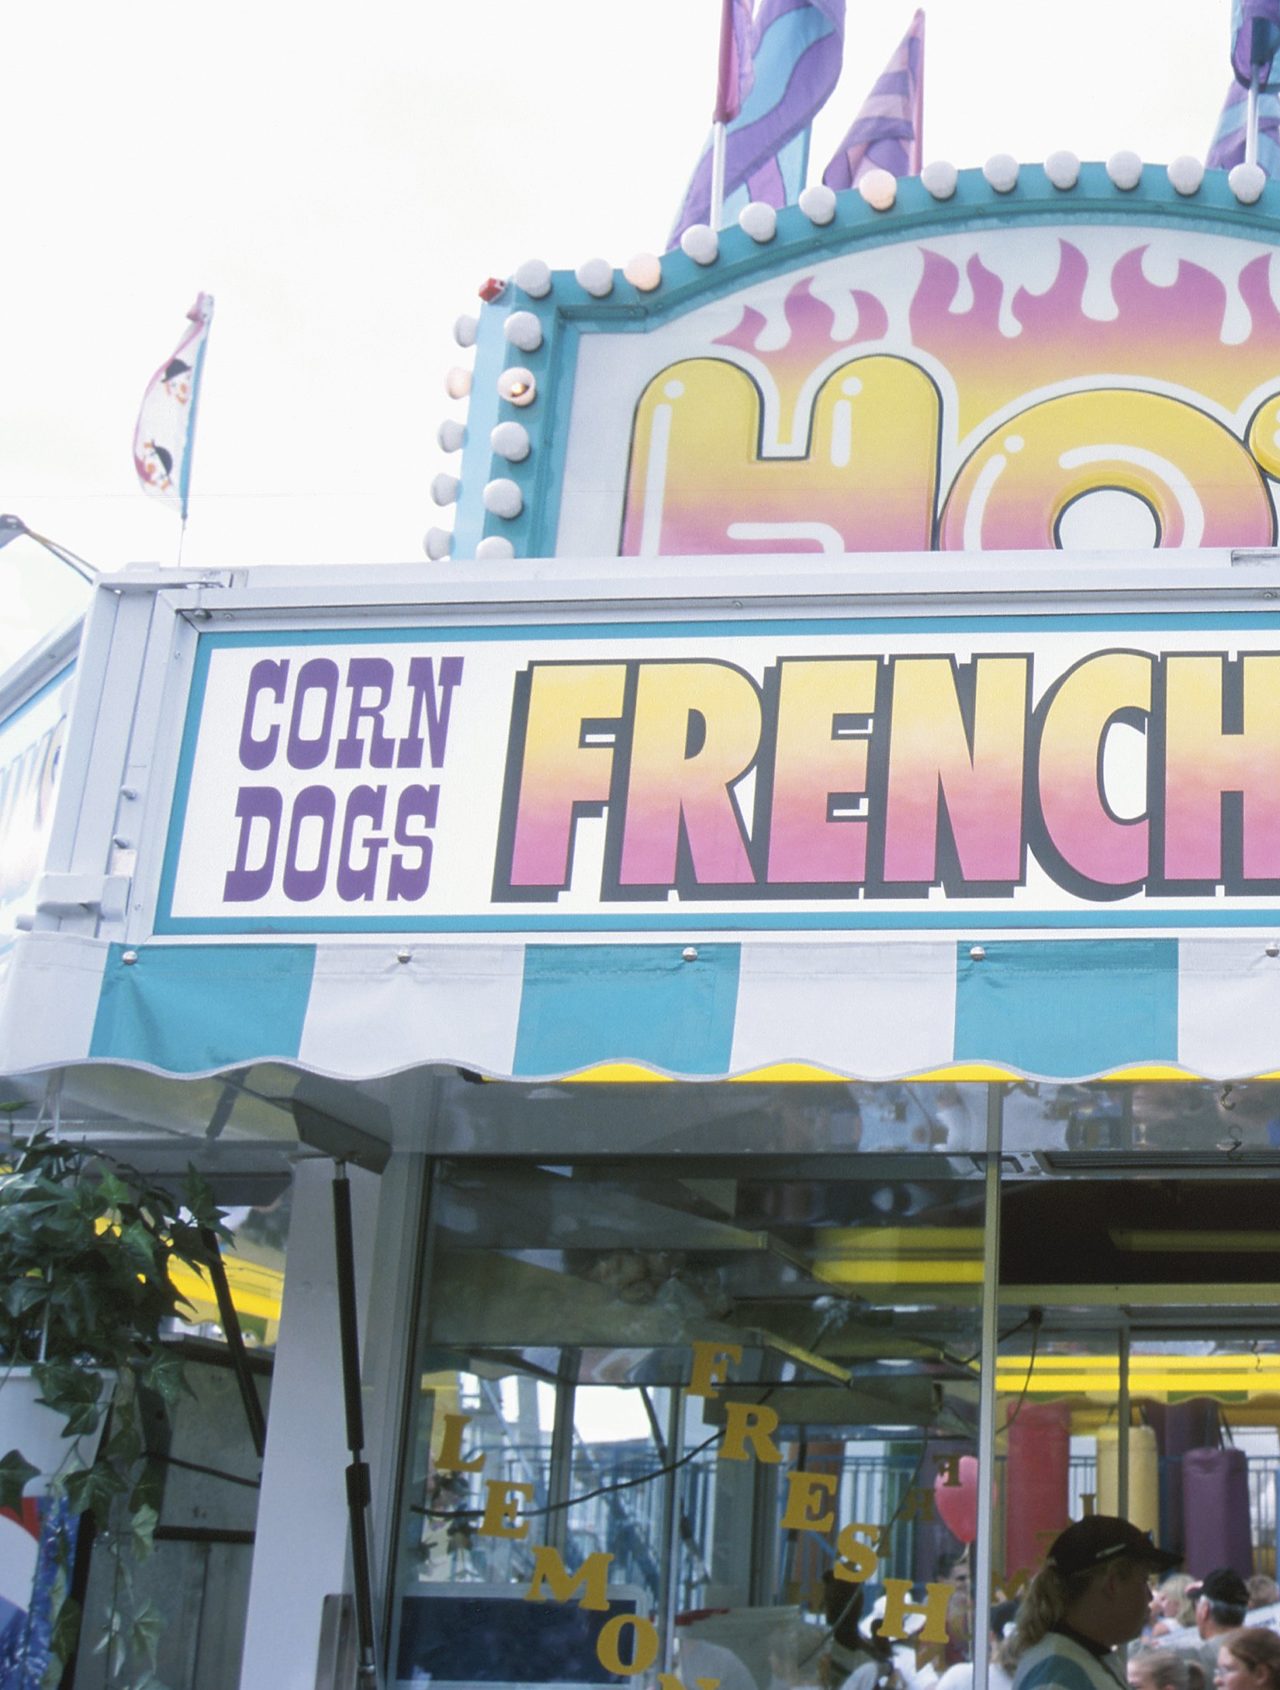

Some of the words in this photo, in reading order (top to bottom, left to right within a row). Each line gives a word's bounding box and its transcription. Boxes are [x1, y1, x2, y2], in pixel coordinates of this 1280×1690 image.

[239, 656, 464, 771] CORN
[223, 784, 440, 902] DOGS
[685, 1341, 955, 1643] FRESH
